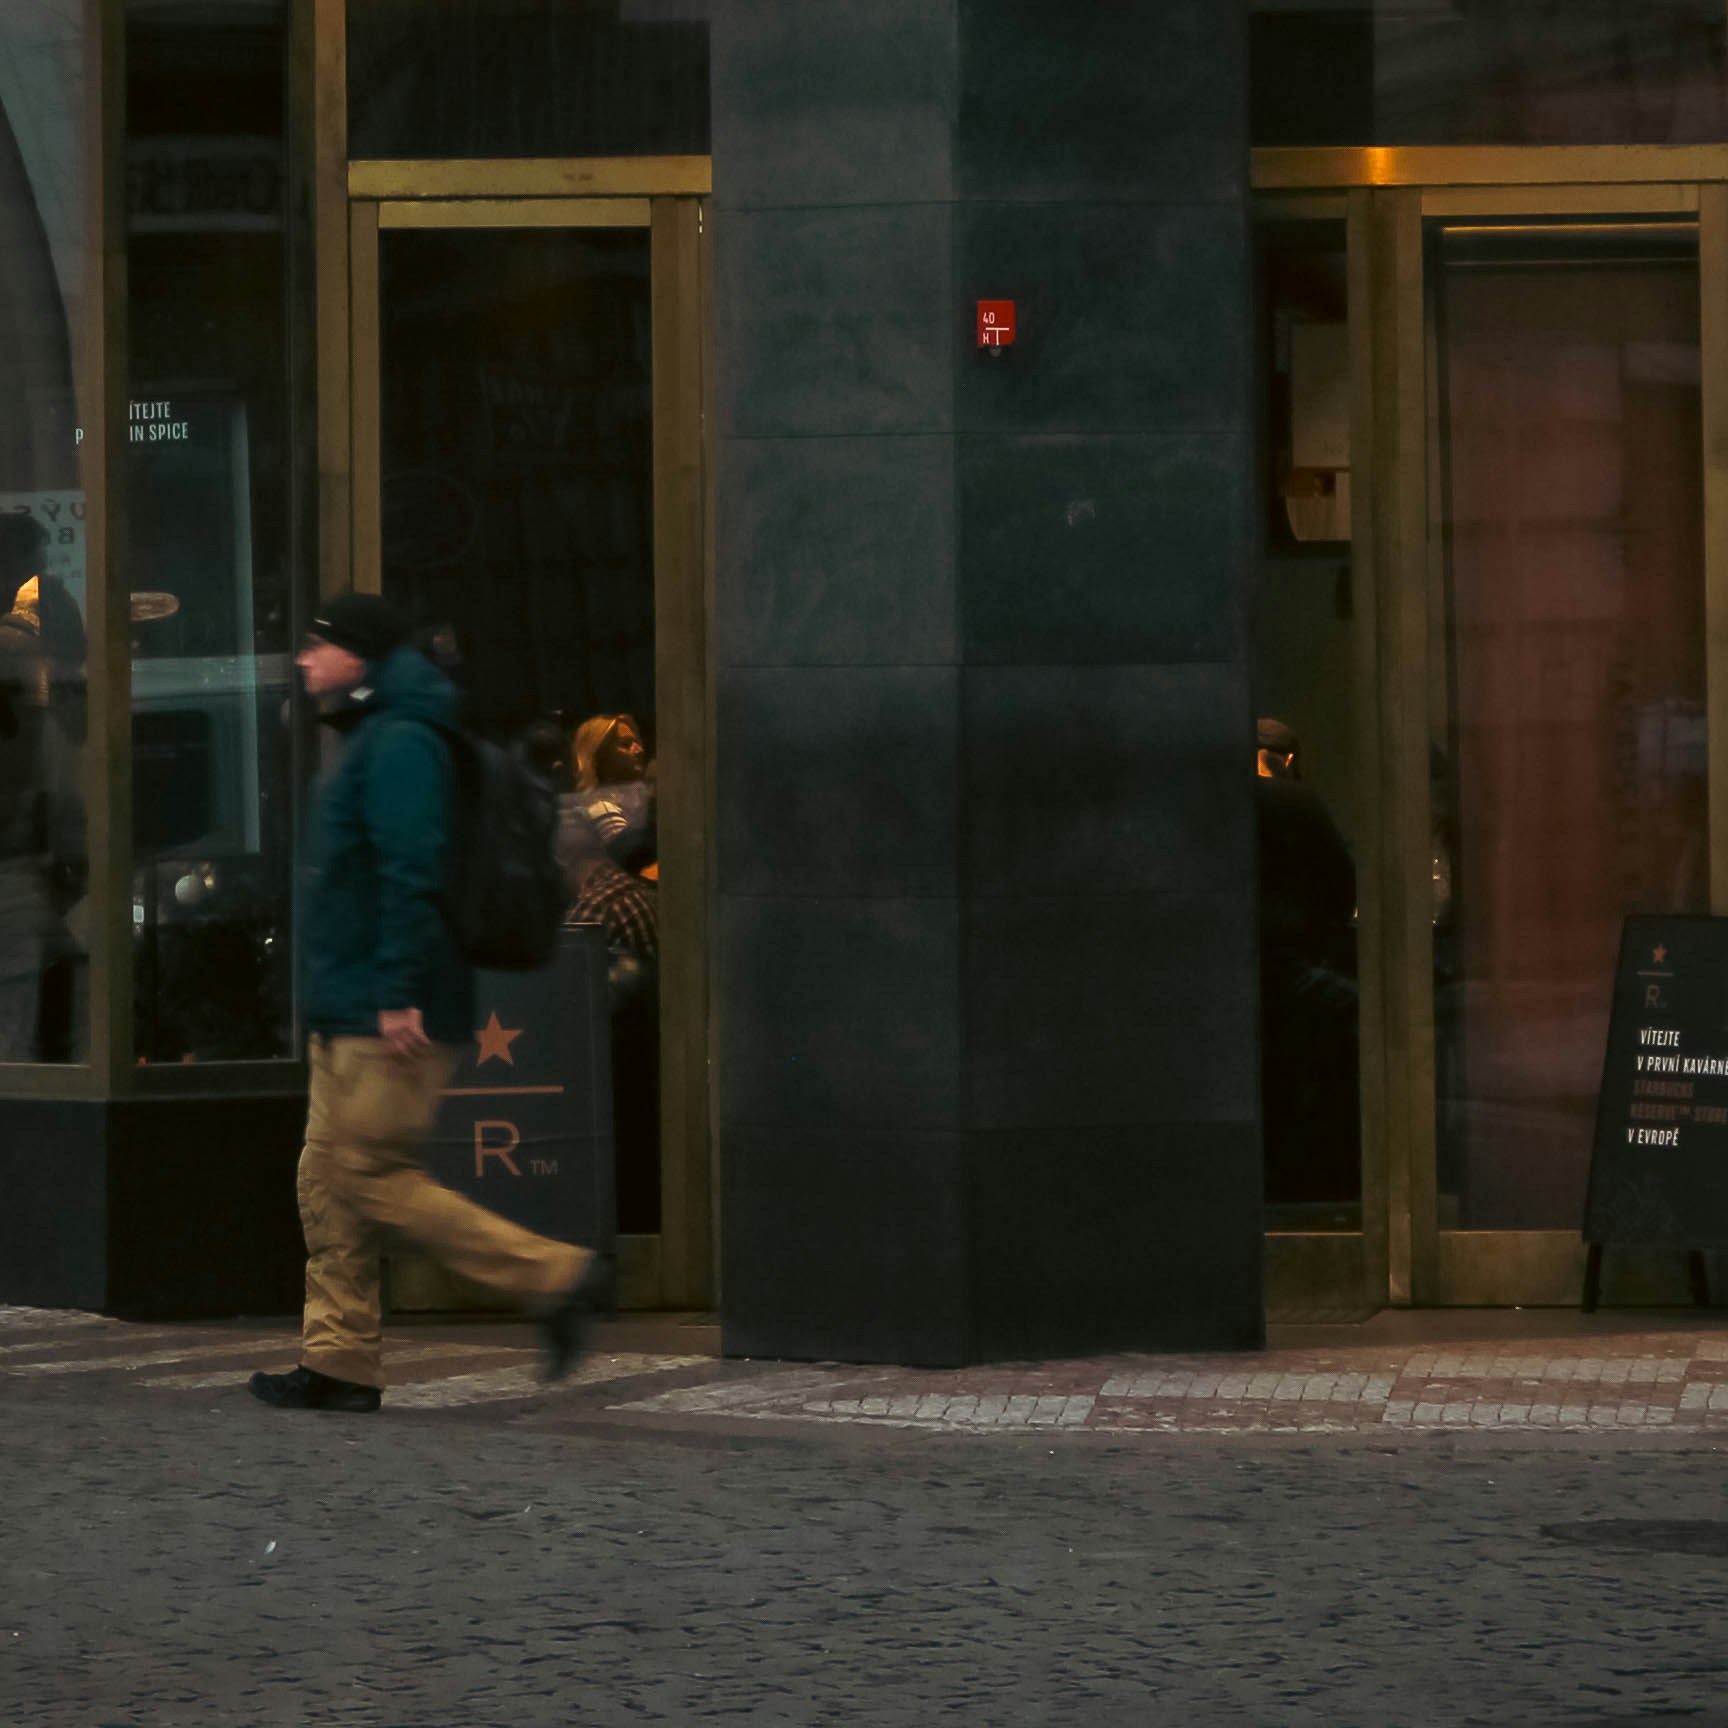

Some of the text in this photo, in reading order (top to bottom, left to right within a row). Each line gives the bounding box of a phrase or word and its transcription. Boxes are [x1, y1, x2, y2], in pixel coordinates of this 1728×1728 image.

[982, 311, 996, 325] 40
[982, 332, 990, 345] H
[129, 400, 172, 421] ÍTEJTE
[149, 421, 190, 442] SPICE
[1640, 1026, 1681, 1047] VÍTEJTE
[1637, 1055, 1645, 1071] V
[1647, 1053, 1681, 1073] PRVNÍ
[1632, 1079, 1696, 1099] STARBUCKS
[1627, 1127, 1681, 1147] V EVROPĚ
[474, 1120, 521, 1177] R
